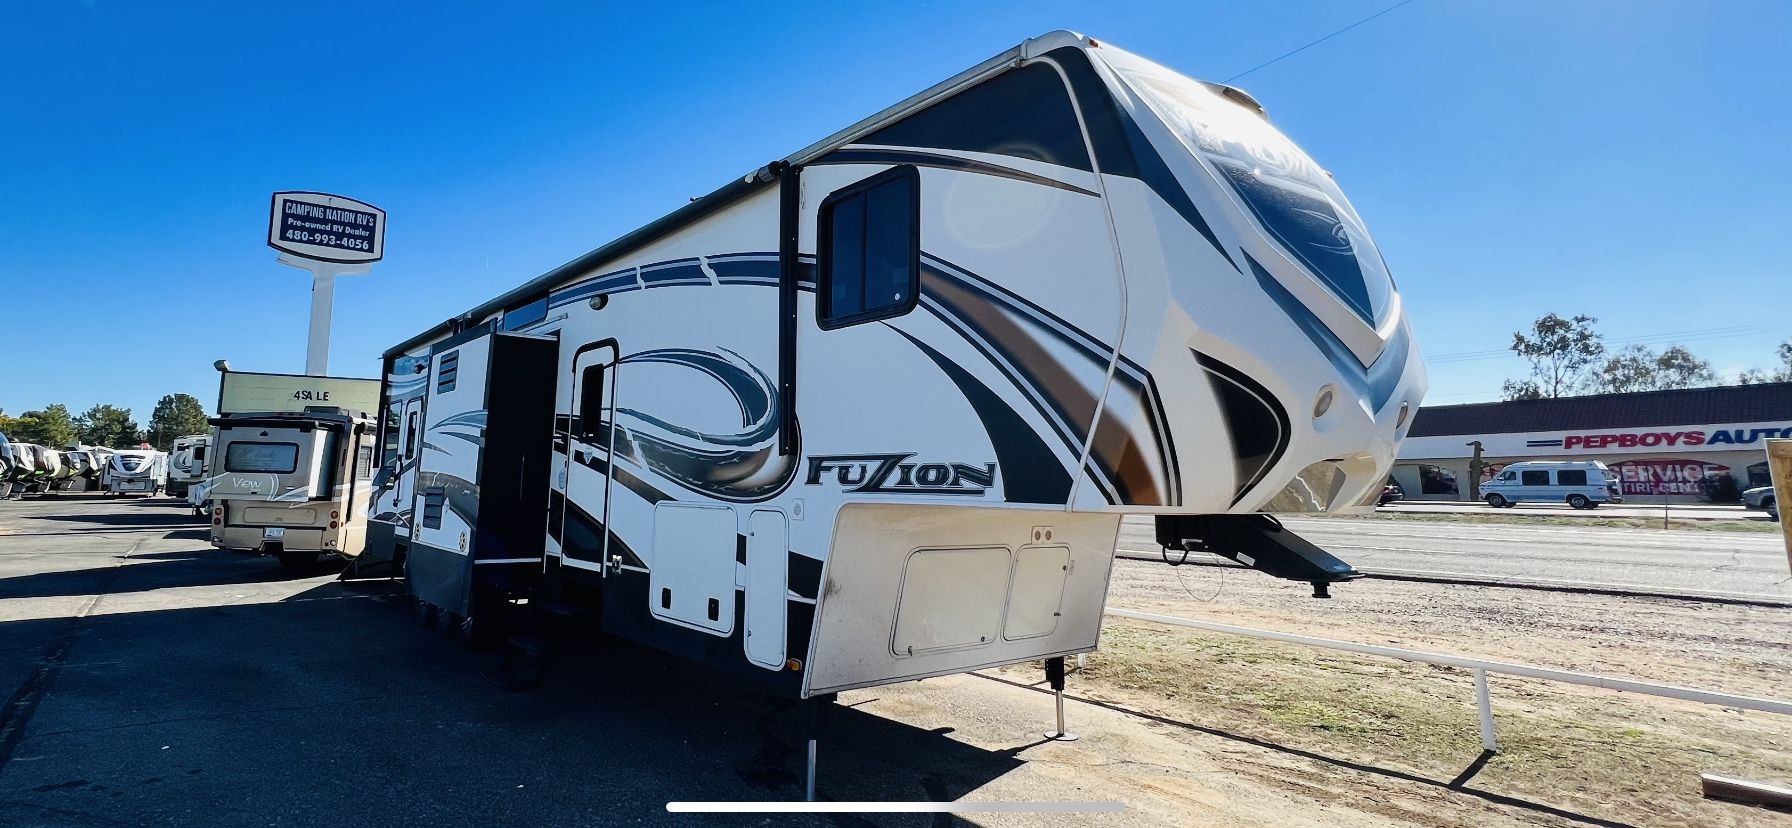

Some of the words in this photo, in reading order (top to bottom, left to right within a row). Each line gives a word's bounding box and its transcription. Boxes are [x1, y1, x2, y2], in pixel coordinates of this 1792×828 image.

[285, 202, 324, 219] CAMPING
[326, 208, 355, 224] NATION
[287, 217, 331, 231] Pre-owned
[333, 224, 343, 233] RV
[345, 227, 369, 237] Dealer
[286, 229, 369, 250] 480-993-4056
[232, 477, 263, 488] View
